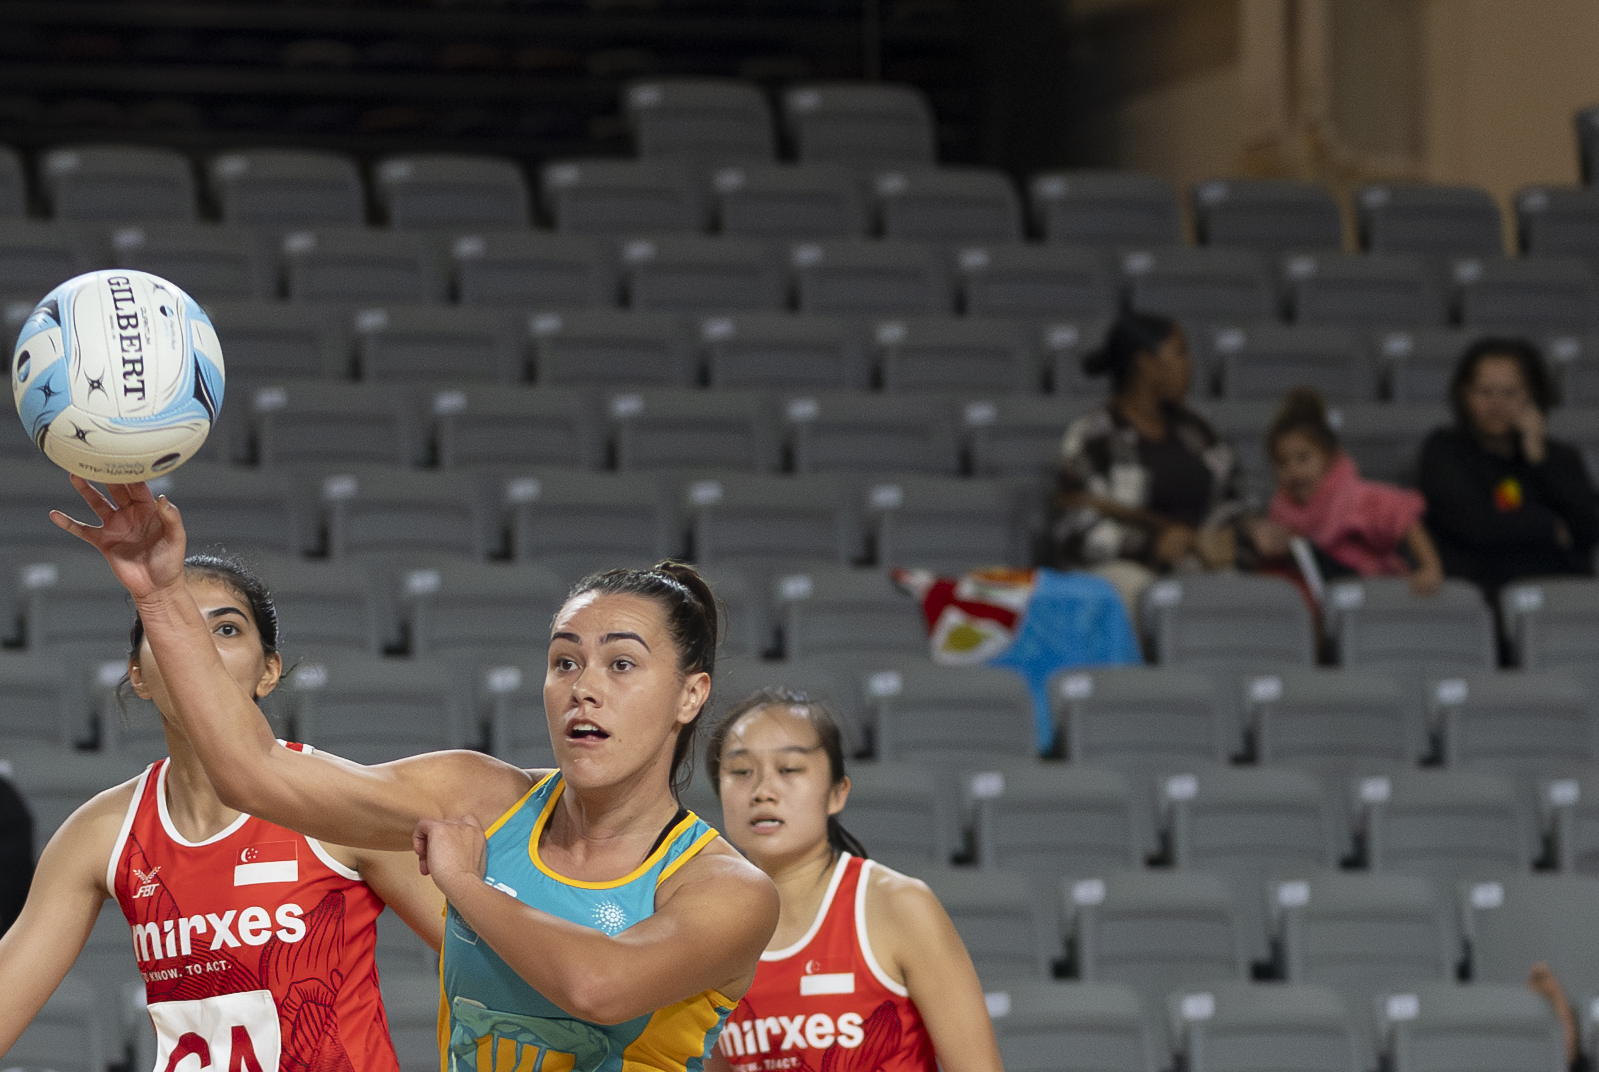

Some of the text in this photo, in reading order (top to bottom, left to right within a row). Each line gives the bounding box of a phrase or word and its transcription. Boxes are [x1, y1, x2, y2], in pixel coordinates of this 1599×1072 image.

[107, 276, 146, 401] GILBERT
[132, 903, 306, 962] mirxes
[185, 964, 202, 975] TO
